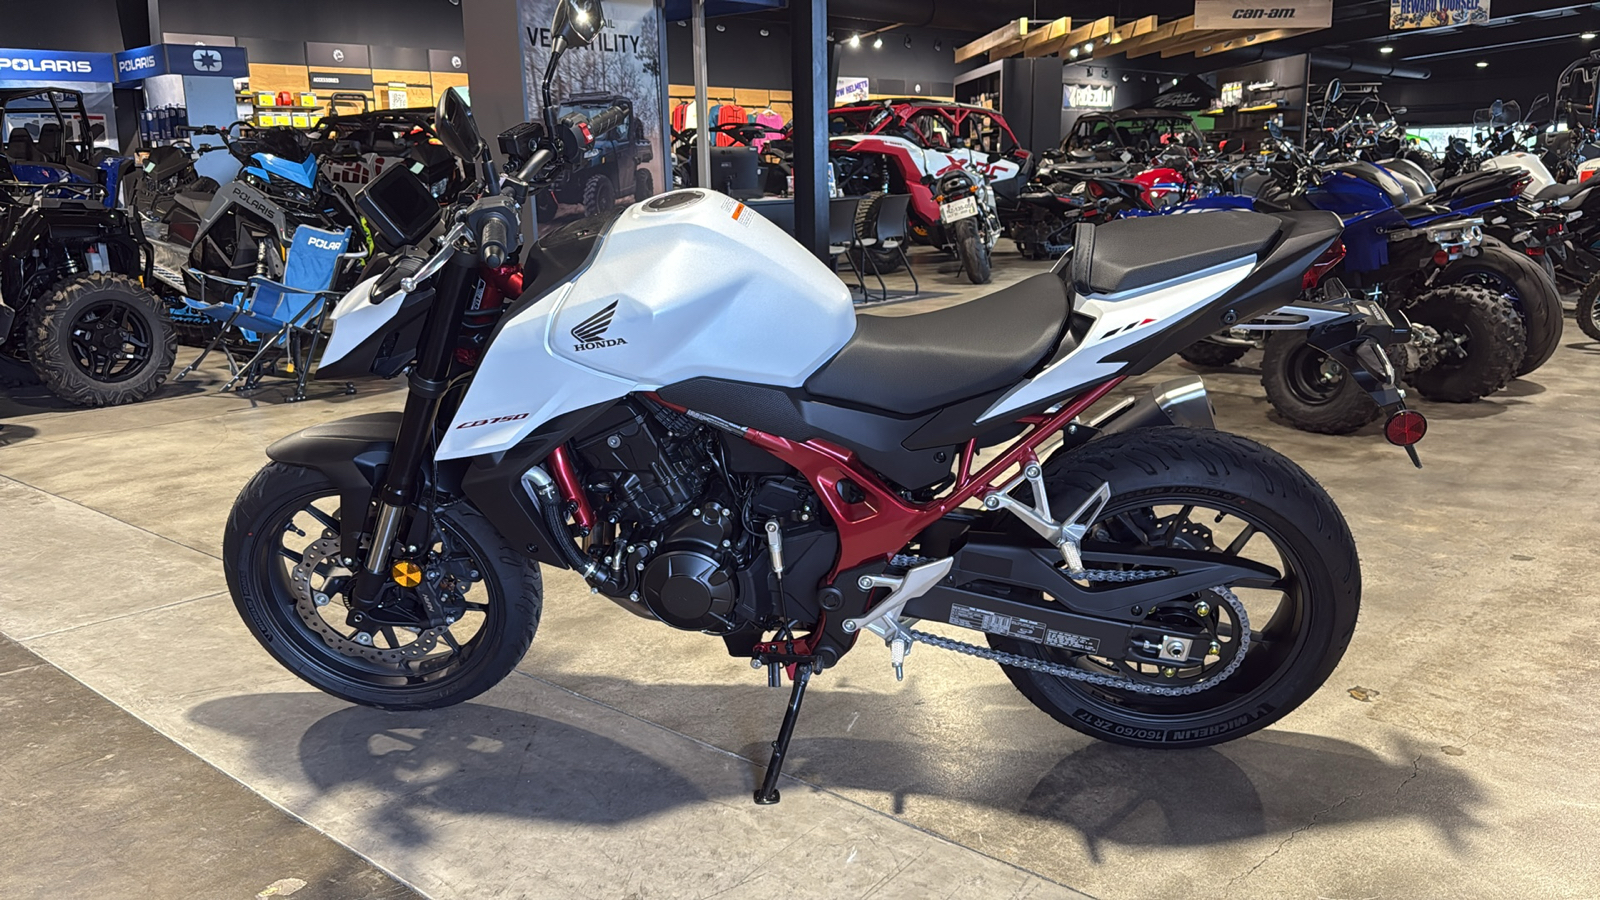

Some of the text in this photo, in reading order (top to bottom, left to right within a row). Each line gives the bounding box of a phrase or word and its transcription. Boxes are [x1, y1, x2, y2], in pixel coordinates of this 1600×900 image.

[1231, 8, 1296, 19] can-am
[526, 26, 640, 54] VEILITY
[0, 58, 92, 73] POLARIS
[119, 55, 156, 73] POLARIS
[232, 187, 276, 220] POLARIS
[573, 337, 629, 352] HONDA
[455, 412, 530, 430] CB750
[1077, 712, 1248, 741] MICHELIN 160/60 ZR 17
